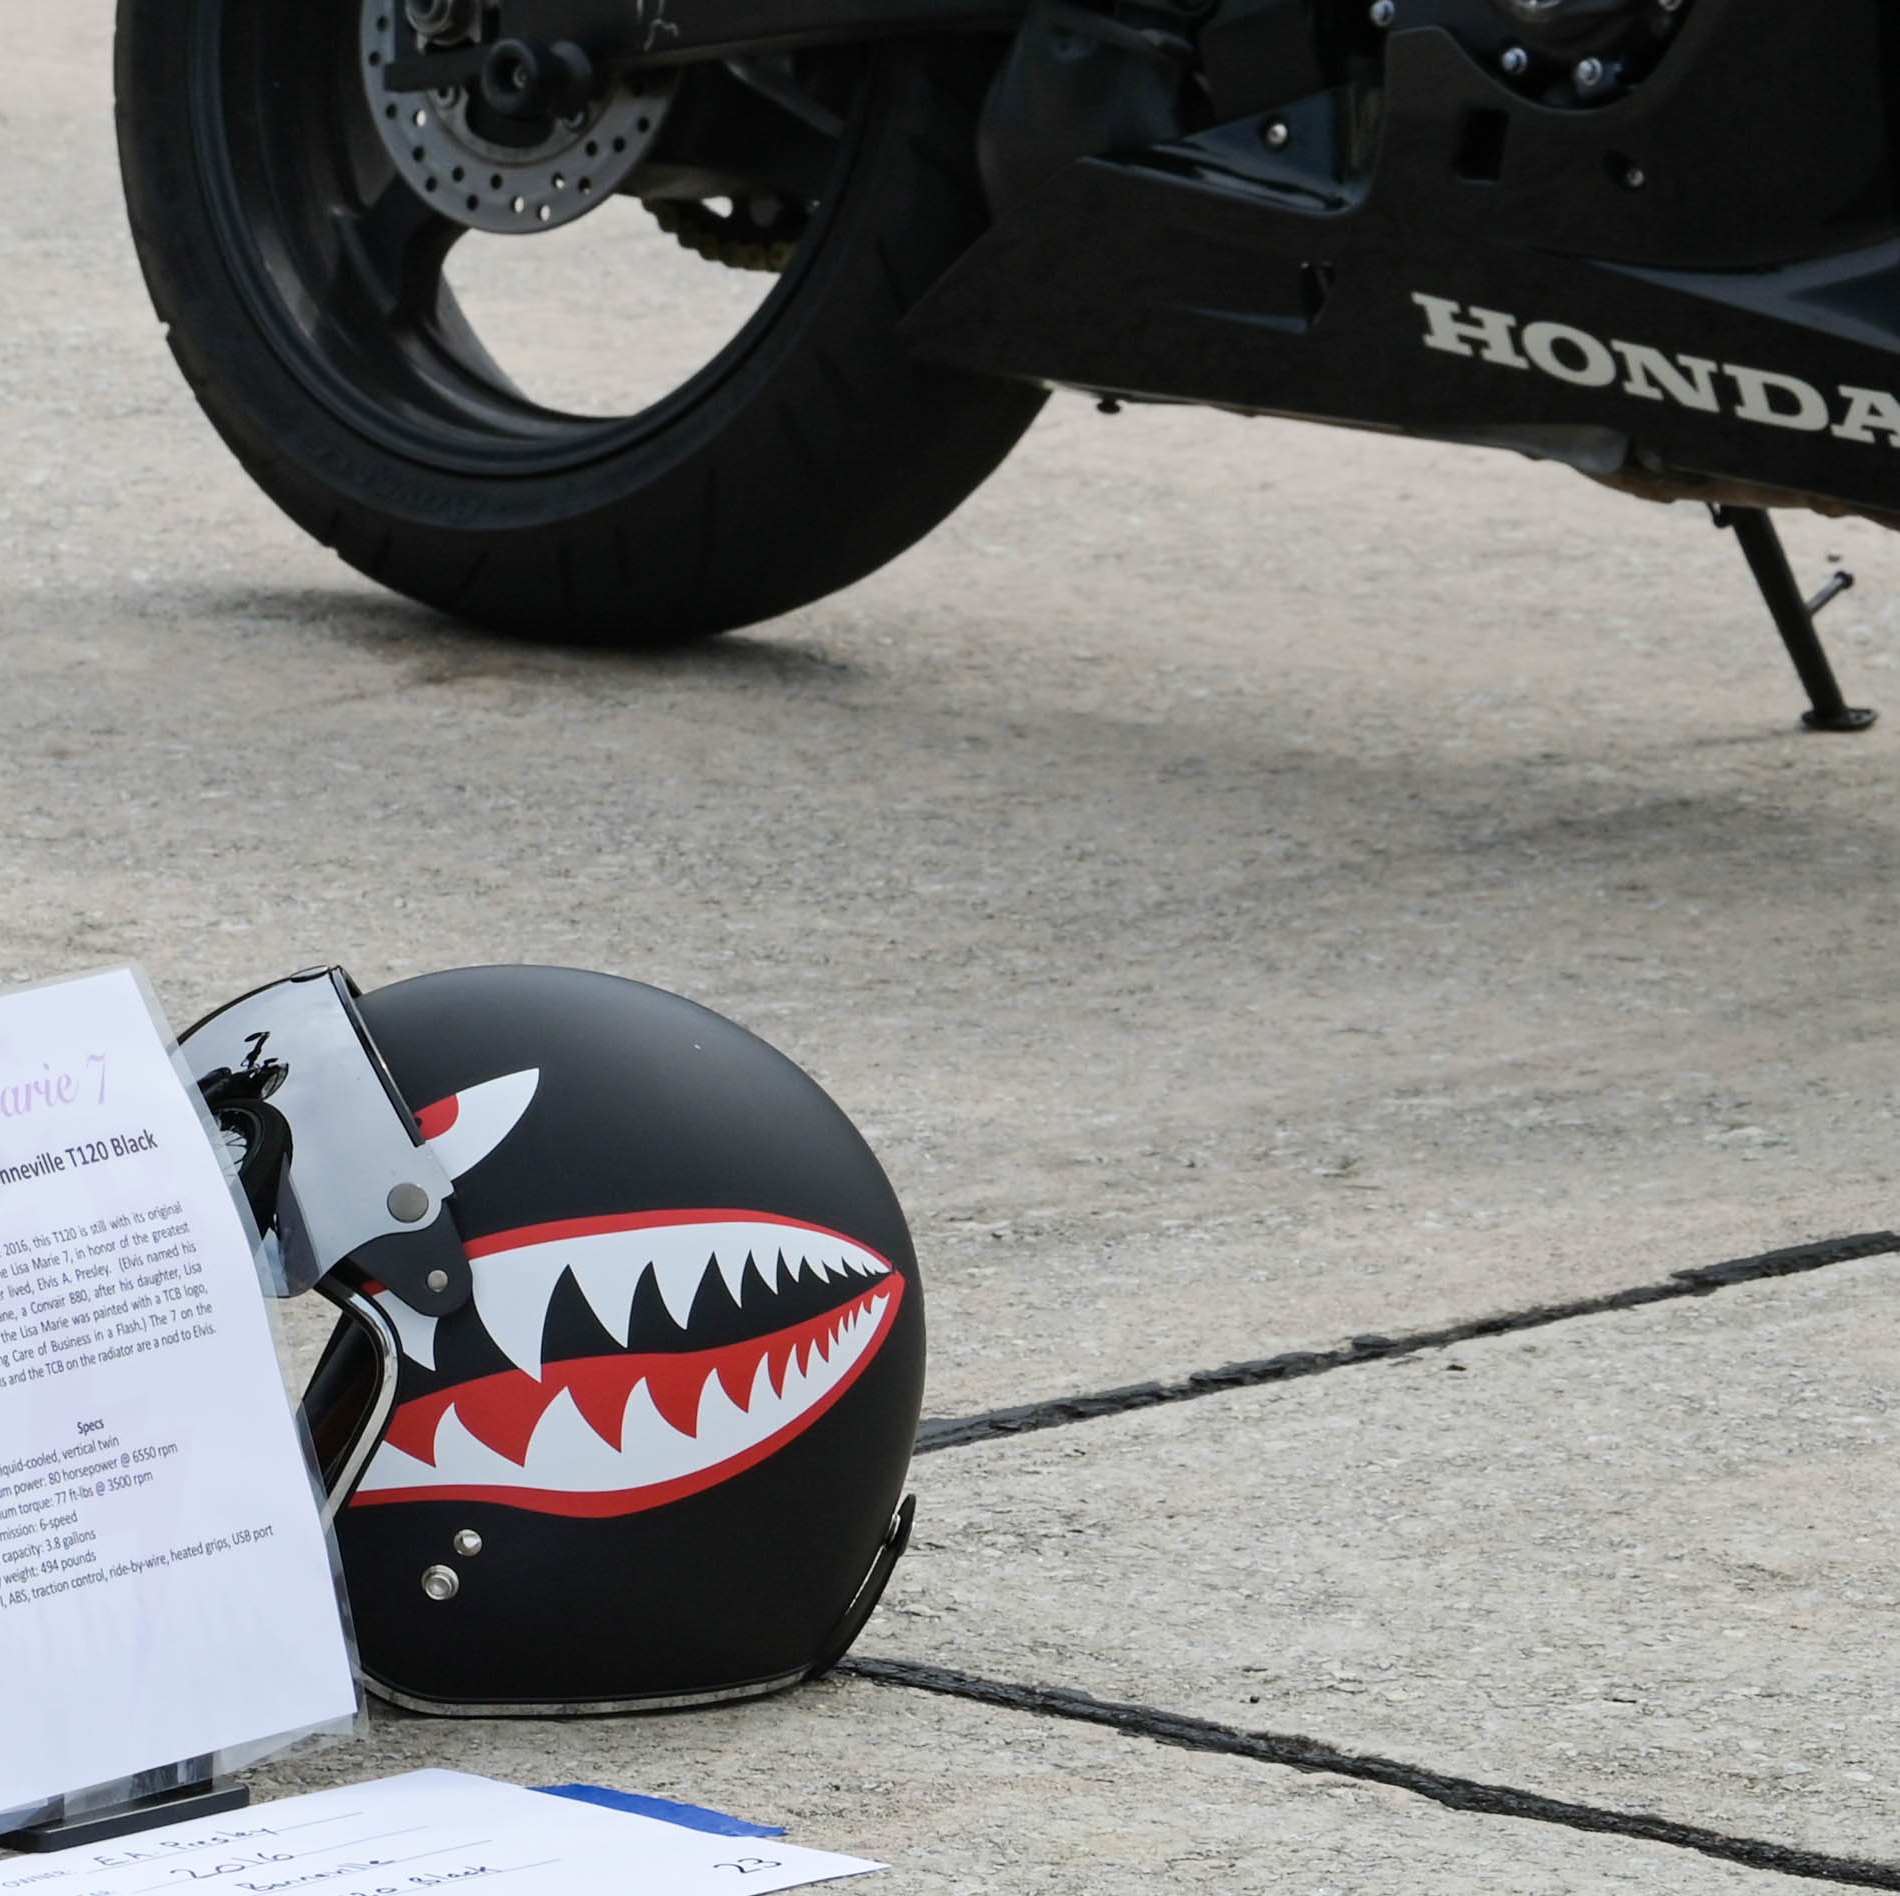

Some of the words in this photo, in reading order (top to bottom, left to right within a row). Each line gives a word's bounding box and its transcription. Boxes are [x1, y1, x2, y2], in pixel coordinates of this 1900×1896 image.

[1411, 291, 1900, 450] HONDA
[85, 1052, 106, 1105] 7
[64, 1140, 109, 1167] T120
[109, 1128, 158, 1157] Black
[2, 1238, 32, 1256] 2016,
[31, 1234, 51, 1248] this
[50, 1226, 77, 1243] T120
[77, 1225, 88, 1237] is
[89, 1219, 107, 1235] still
[108, 1214, 131, 1230] with
[132, 1212, 145, 1223] its
[146, 1200, 183, 1220] original
[9, 1262, 30, 1276] Lisa
[30, 1255, 61, 1270] Marie
[61, 1249, 74, 1264] 7,
[74, 1247, 86, 1259] in
[86, 1240, 116, 1256] honor
[118, 1234, 129, 1249] of
[131, 1232, 149, 1246] the
[151, 1221, 190, 1243] greatest
[6, 1280, 35, 1298] lived,
[36, 1275, 59, 1291] Elvis
[61, 1271, 72, 1284] A.
[74, 1263, 112, 1281] Presley.
[117, 1253, 144, 1272] (Elvis
[145, 1243, 179, 1263] named
[180, 1240, 197, 1254] his
[20, 1306, 27, 1317] a
[29, 1296, 65, 1314] Convair
[68, 1288, 91, 1305] 880,
[93, 1283, 115, 1299] after
[118, 1278, 134, 1291] his
[136, 1268, 181, 1288] daughter,
[182, 1262, 202, 1276] Lisa
[0, 1329, 17, 1343] the
[18, 1325, 39, 1339] Lisa
[39, 1316, 69, 1333] Marie
[70, 1312, 91, 1325] was
[92, 1299, 129, 1323] painted
[130, 1294, 152, 1311] with
[154, 1294, 162, 1305] a
[161, 1286, 182, 1302] TCB
[182, 1283, 208, 1298] logo,
[11, 1348, 34, 1362] Care
[36, 1340, 48, 1356] of
[49, 1333, 92, 1353] Business
[93, 1330, 104, 1341] in
[106, 1328, 114, 1339] a
[115, 1316, 147, 1336] Flash.)
[147, 1313, 167, 1327] The
[169, 1308, 176, 1321] 7
[179, 1307, 194, 1320] on
[195, 1301, 212, 1316] the
[7, 1368, 27, 1385] and
[26, 1366, 44, 1380] the
[44, 1359, 65, 1375] TCB
[65, 1358, 79, 1370] on
[78, 1352, 96, 1367] the
[97, 1343, 134, 1362] radiator
[135, 1339, 152, 1353] are
[152, 1337, 160, 1349] a
[160, 1329, 180, 1346] nod
[179, 1329, 192, 1341] to
[191, 1323, 216, 1338] Elvis.
[60, 1438, 96, 1460] vertical
[96, 1435, 120, 1450] twin
[76, 1418, 105, 1436] Specs
[12, 1477, 46, 1496] power:
[47, 1470, 61, 1485] 80
[60, 1457, 117, 1481] horsepower
[119, 1452, 130, 1468] @
[131, 1445, 157, 1463] 6550
[157, 1442, 178, 1458] rpm
[17, 1497, 54, 1515] torque:
[53, 1490, 66, 1504] 77
[68, 1485, 94, 1501] ft-lbs
[94, 1480, 105, 1496] @
[106, 1473, 132, 1492] 3500
[132, 1470, 153, 1486] rpm
[1, 1543, 44, 1563] capacity:
[44, 1535, 61, 1552] 3.8
[61, 1529, 96, 1549] gallons
[38, 1509, 78, 1531] 6-speed
[2, 1565, 39, 1584] weight:
[40, 1558, 59, 1573] 494
[59, 1548, 97, 1572] pounds
[8, 1588, 31, 1605] ABS,
[30, 1580, 70, 1599] traction
[70, 1567, 108, 1589] control,
[108, 1553, 170, 1578] ride-by-wire,
[169, 1540, 204, 1562] heated
[204, 1537, 231, 1556] grips,
[230, 1528, 252, 1545] USB
[252, 1524, 273, 1543] port
[169, 1852, 296, 1880] 2016
[712, 1856, 783, 1875] 23
